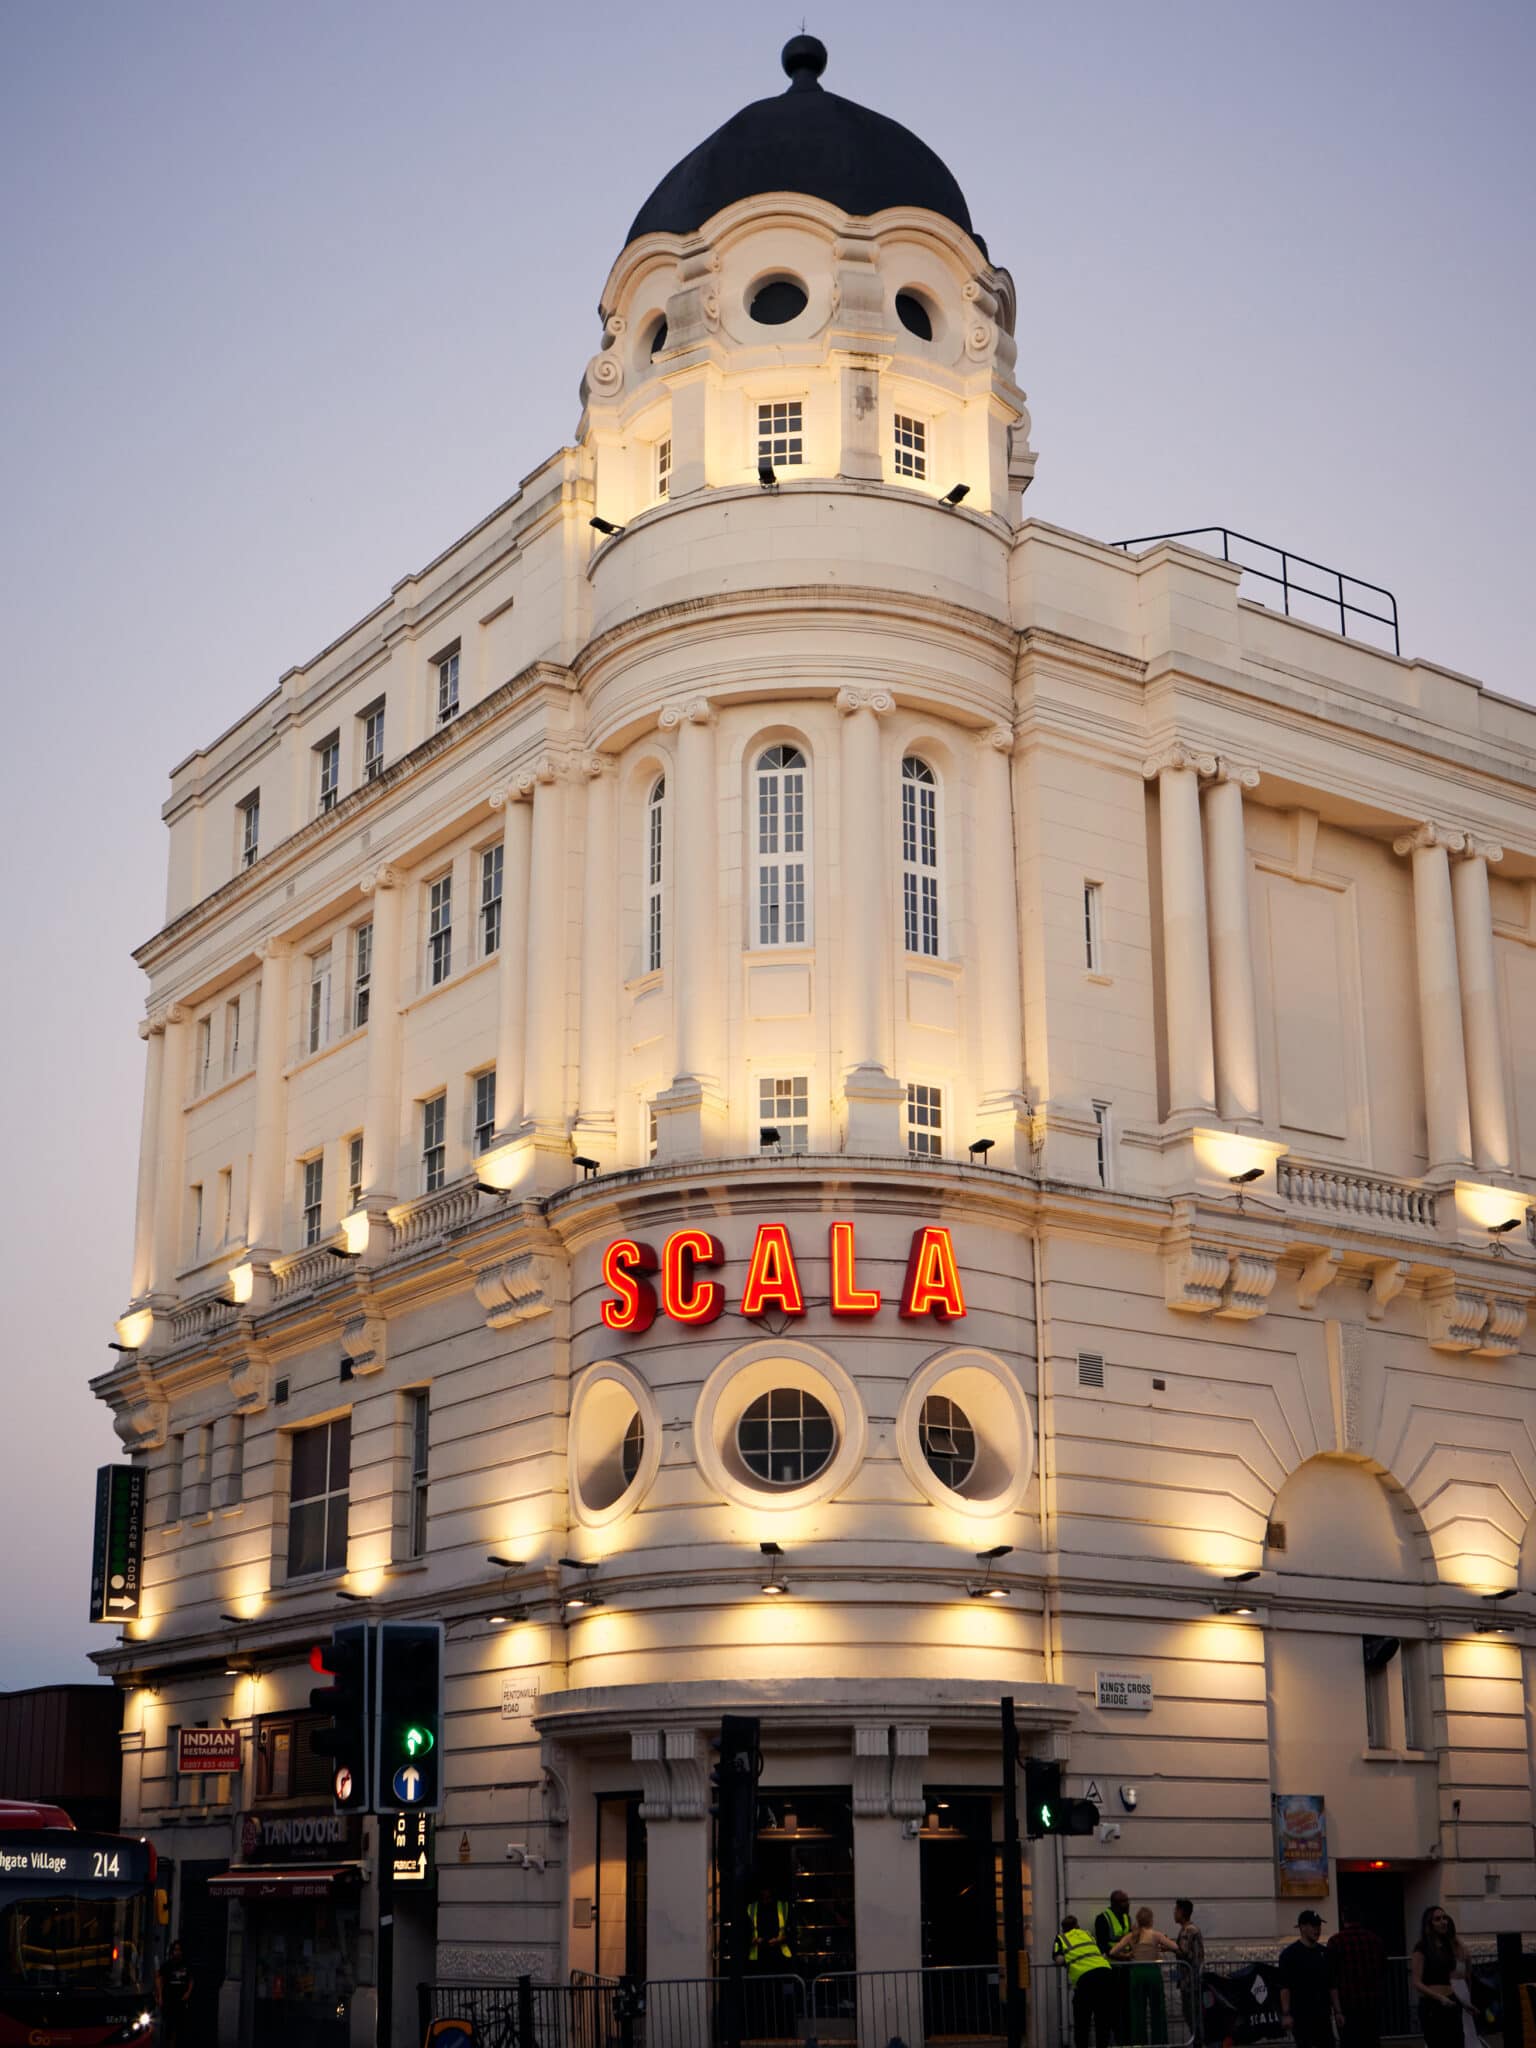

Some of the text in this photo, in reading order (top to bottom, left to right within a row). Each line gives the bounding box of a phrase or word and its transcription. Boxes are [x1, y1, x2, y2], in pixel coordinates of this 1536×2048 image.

[601, 1222, 968, 1333] SCALA
[126, 1558, 137, 1590] ROOM
[504, 1688, 537, 1700] PENTONVILLE
[1100, 1682, 1151, 1694] KING'S CROSS
[1101, 1694, 1128, 1705] BRIDGE
[504, 1704, 519, 1713] ROAD
[183, 1733, 236, 1746] INDIAN
[183, 1747, 235, 1756] RESTAURANT
[31, 1851, 67, 1873] Village
[93, 1851, 120, 1878] 214
